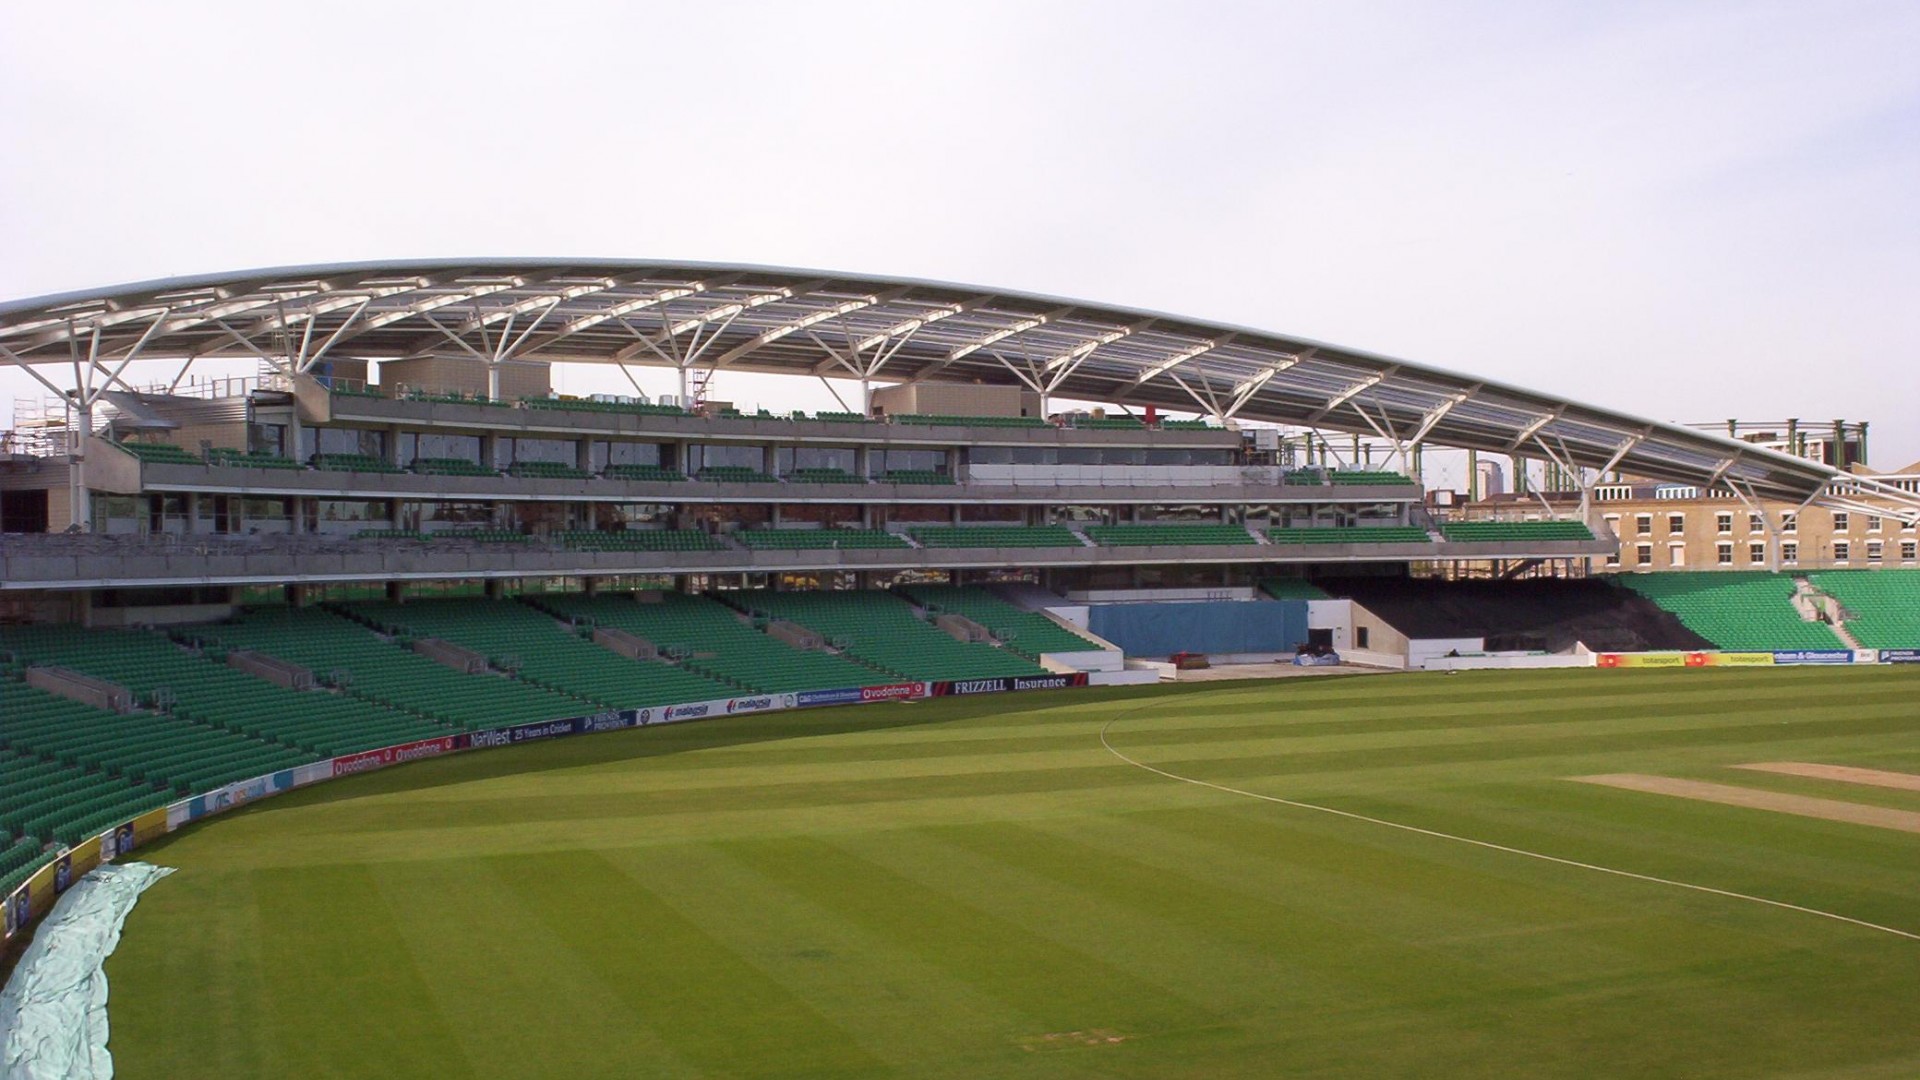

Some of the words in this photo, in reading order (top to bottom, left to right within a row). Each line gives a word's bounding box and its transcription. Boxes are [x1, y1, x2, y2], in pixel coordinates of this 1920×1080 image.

[954, 679, 1007, 694] FRIZZELL
[1014, 677, 1067, 690] Insurance
[471, 729, 511, 748] NatWest
